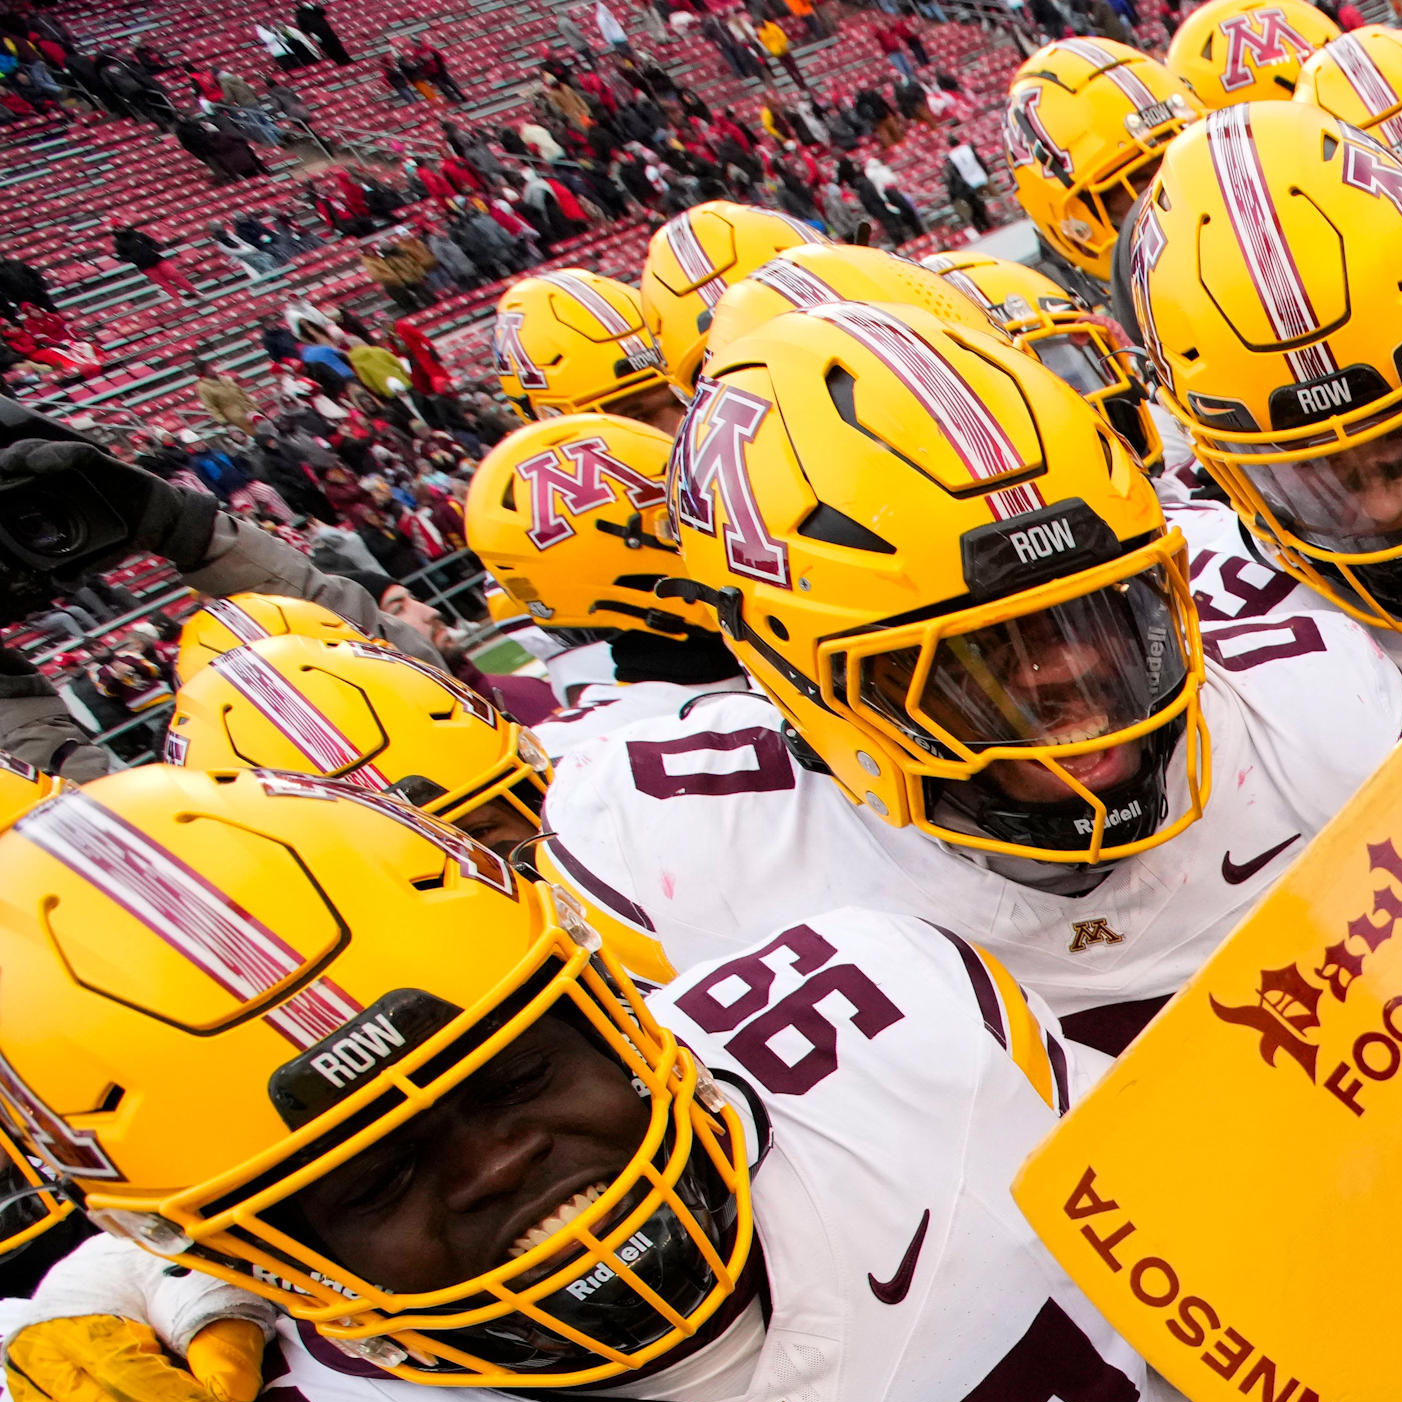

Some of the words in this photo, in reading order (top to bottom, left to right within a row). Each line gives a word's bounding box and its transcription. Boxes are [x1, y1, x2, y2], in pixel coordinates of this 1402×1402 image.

[1219, 8, 1316, 92] M
[1297, 380, 1353, 414] ROW
[517, 436, 668, 550] M
[667, 376, 792, 590] M
[1010, 518, 1077, 564] ROW
[1070, 919, 1122, 951] M
[311, 1013, 406, 1089] ROW
